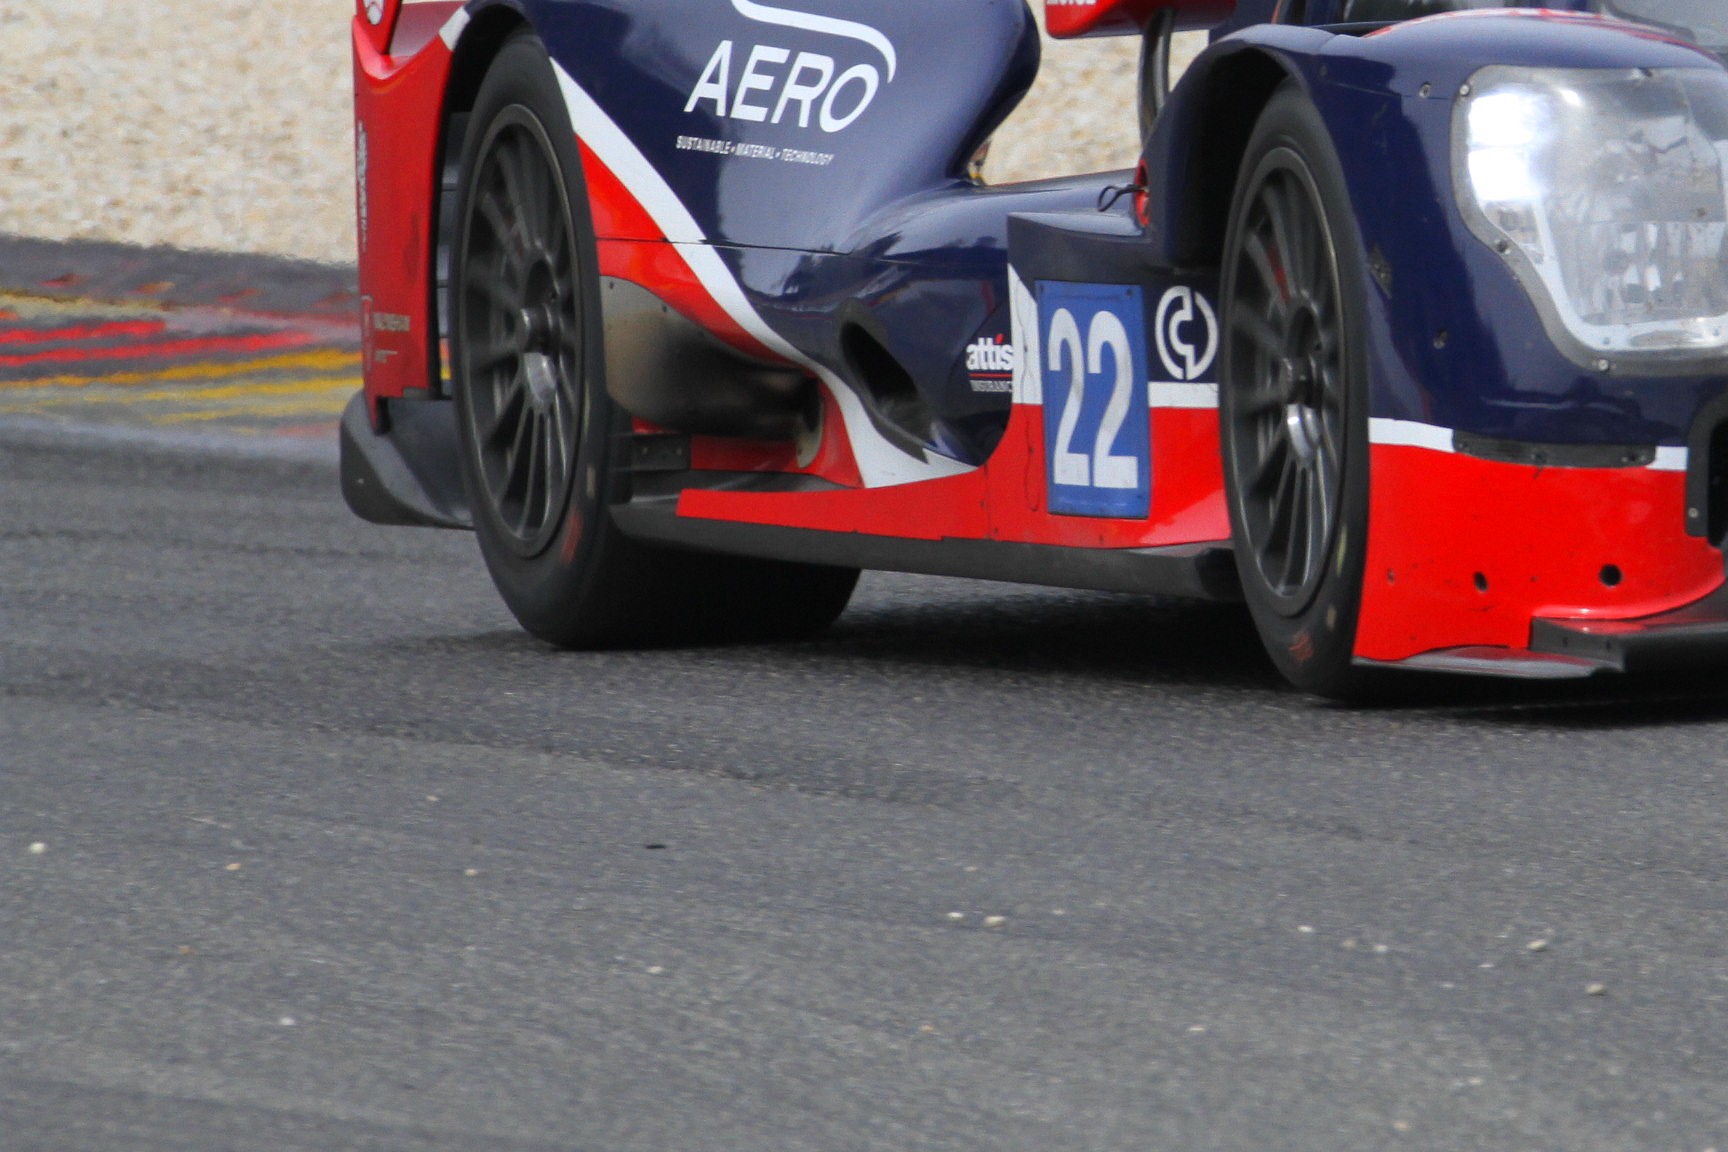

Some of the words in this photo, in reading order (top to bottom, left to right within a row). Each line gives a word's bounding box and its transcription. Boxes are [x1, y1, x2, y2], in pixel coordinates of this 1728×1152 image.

[684, 40, 880, 134] AERO
[675, 135, 732, 155] SUSTAINABLE
[734, 142, 777, 160] MATERIAL
[779, 147, 835, 166] TECHNOLOGY
[965, 333, 1015, 371] attis
[1048, 307, 1139, 489] 22
